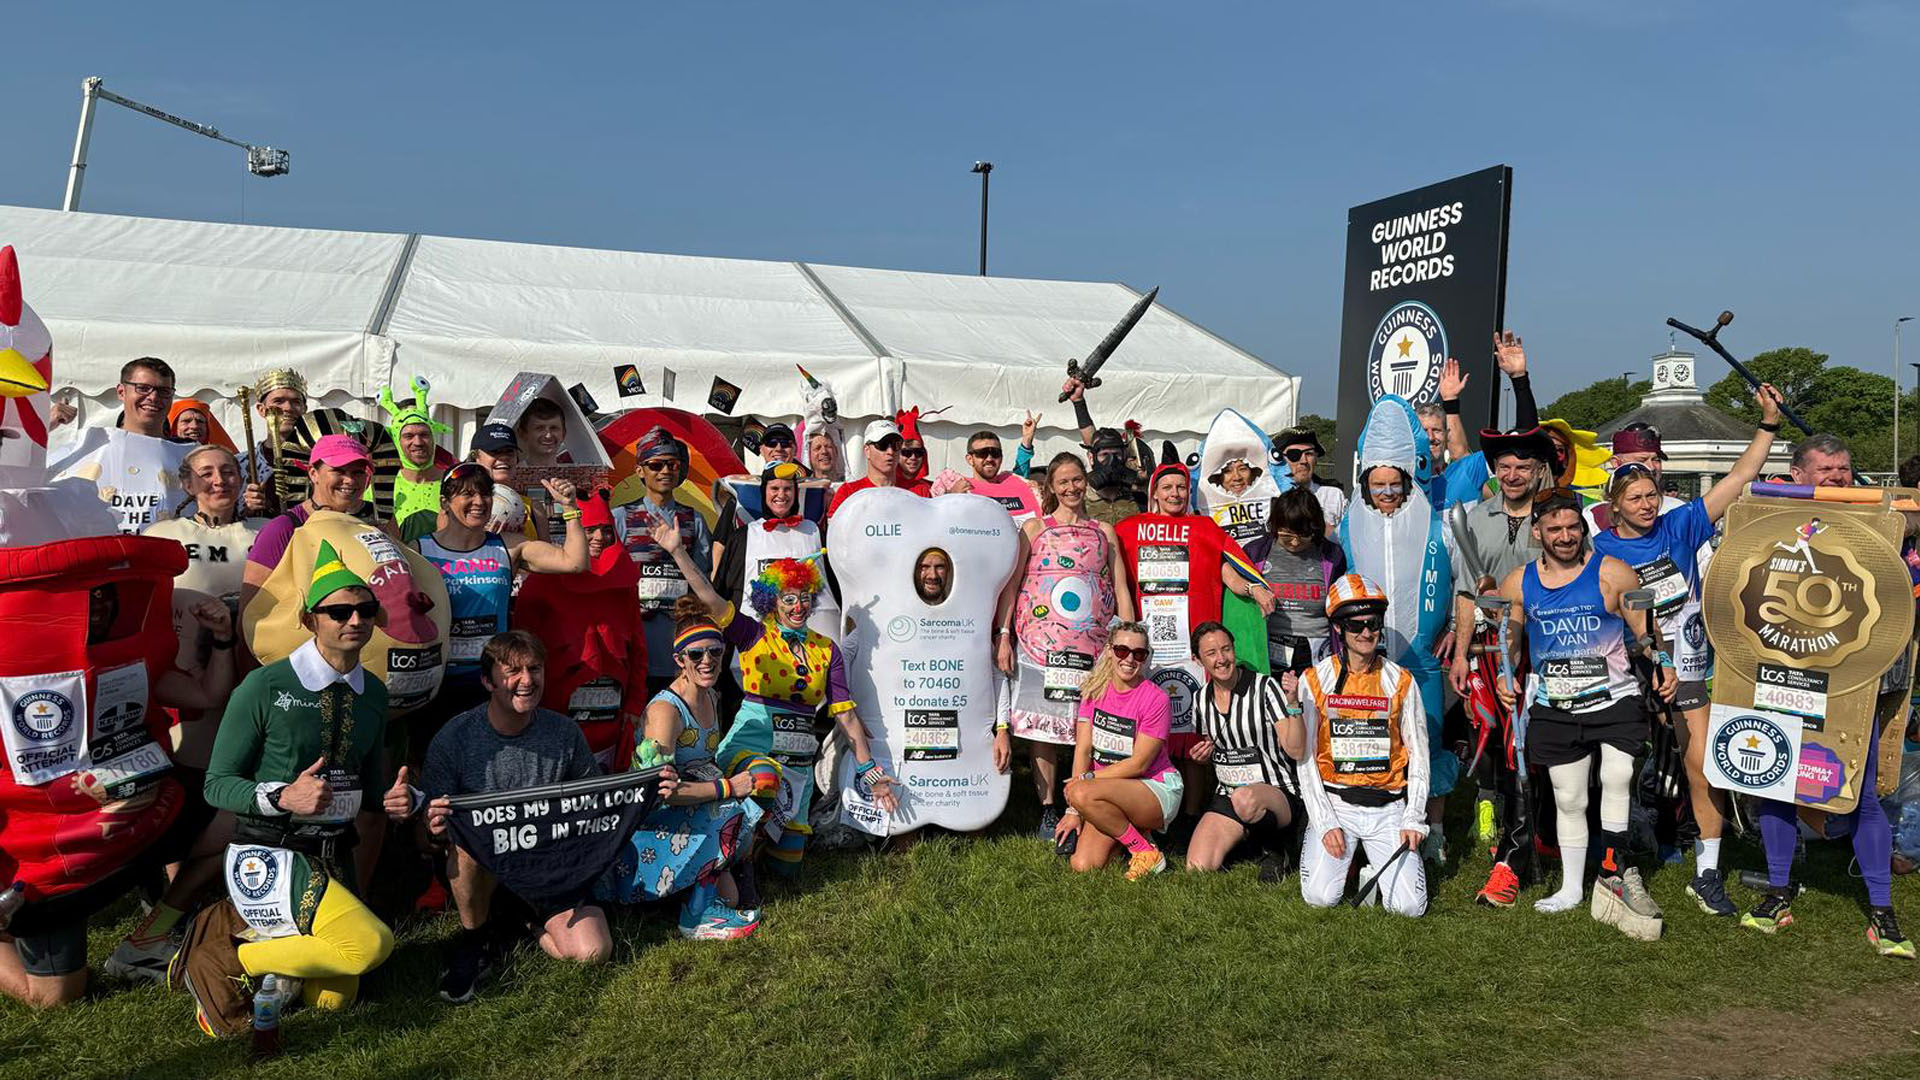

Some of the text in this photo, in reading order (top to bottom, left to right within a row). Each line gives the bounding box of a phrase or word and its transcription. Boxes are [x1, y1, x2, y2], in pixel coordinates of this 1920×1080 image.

[1371, 201, 1464, 244] GUINNESS
[1381, 231, 1447, 265] WORLD
[1370, 254, 1455, 291] RECORDS
[1378, 309, 1437, 346] GUINNESS
[112, 495, 158, 507] DAVE
[1229, 503, 1264, 523] RACE
[865, 524, 902, 537] OLLIE
[1137, 523, 1190, 542] NOELLE
[1770, 557, 1808, 572] SIMON'S
[1537, 606, 1580, 616] Breakthrough
[1541, 615, 1601, 636] DAVID
[1557, 633, 1588, 647] VAN
[1758, 623, 1840, 653] MARATHON
[391, 651, 418, 669] tcs
[901, 660, 964, 671] Text BONE
[1547, 662, 1569, 675] tcs
[904, 677, 961, 689] to 70460
[1154, 672, 1194, 686] UINNESS
[1761, 666, 1786, 683] tcs
[19, 692, 65, 709] GUINNESS
[894, 695, 968, 707] to donate £5
[1765, 690, 1815, 711] 40983
[41, 709, 72, 740] RECORDS
[907, 712, 927, 725] tcs
[1333, 722, 1354, 736] tcs
[1725, 720, 1783, 744] GUINNESS
[912, 731, 950, 745] 40362
[17, 744, 77, 765] OFFICIAL
[1341, 742, 1380, 756] 38179
[20, 753, 77, 774] ATTEMPT
[1717, 742, 1788, 786] WORLD RECORDS
[471, 787, 645, 827] DOES MY BUM LOOK
[848, 803, 883, 818] OFFICIAL
[493, 814, 621, 856] BIG IN THIS?
[252, 867, 276, 898] RECORDS
[243, 907, 283, 918] OFFICIAL
